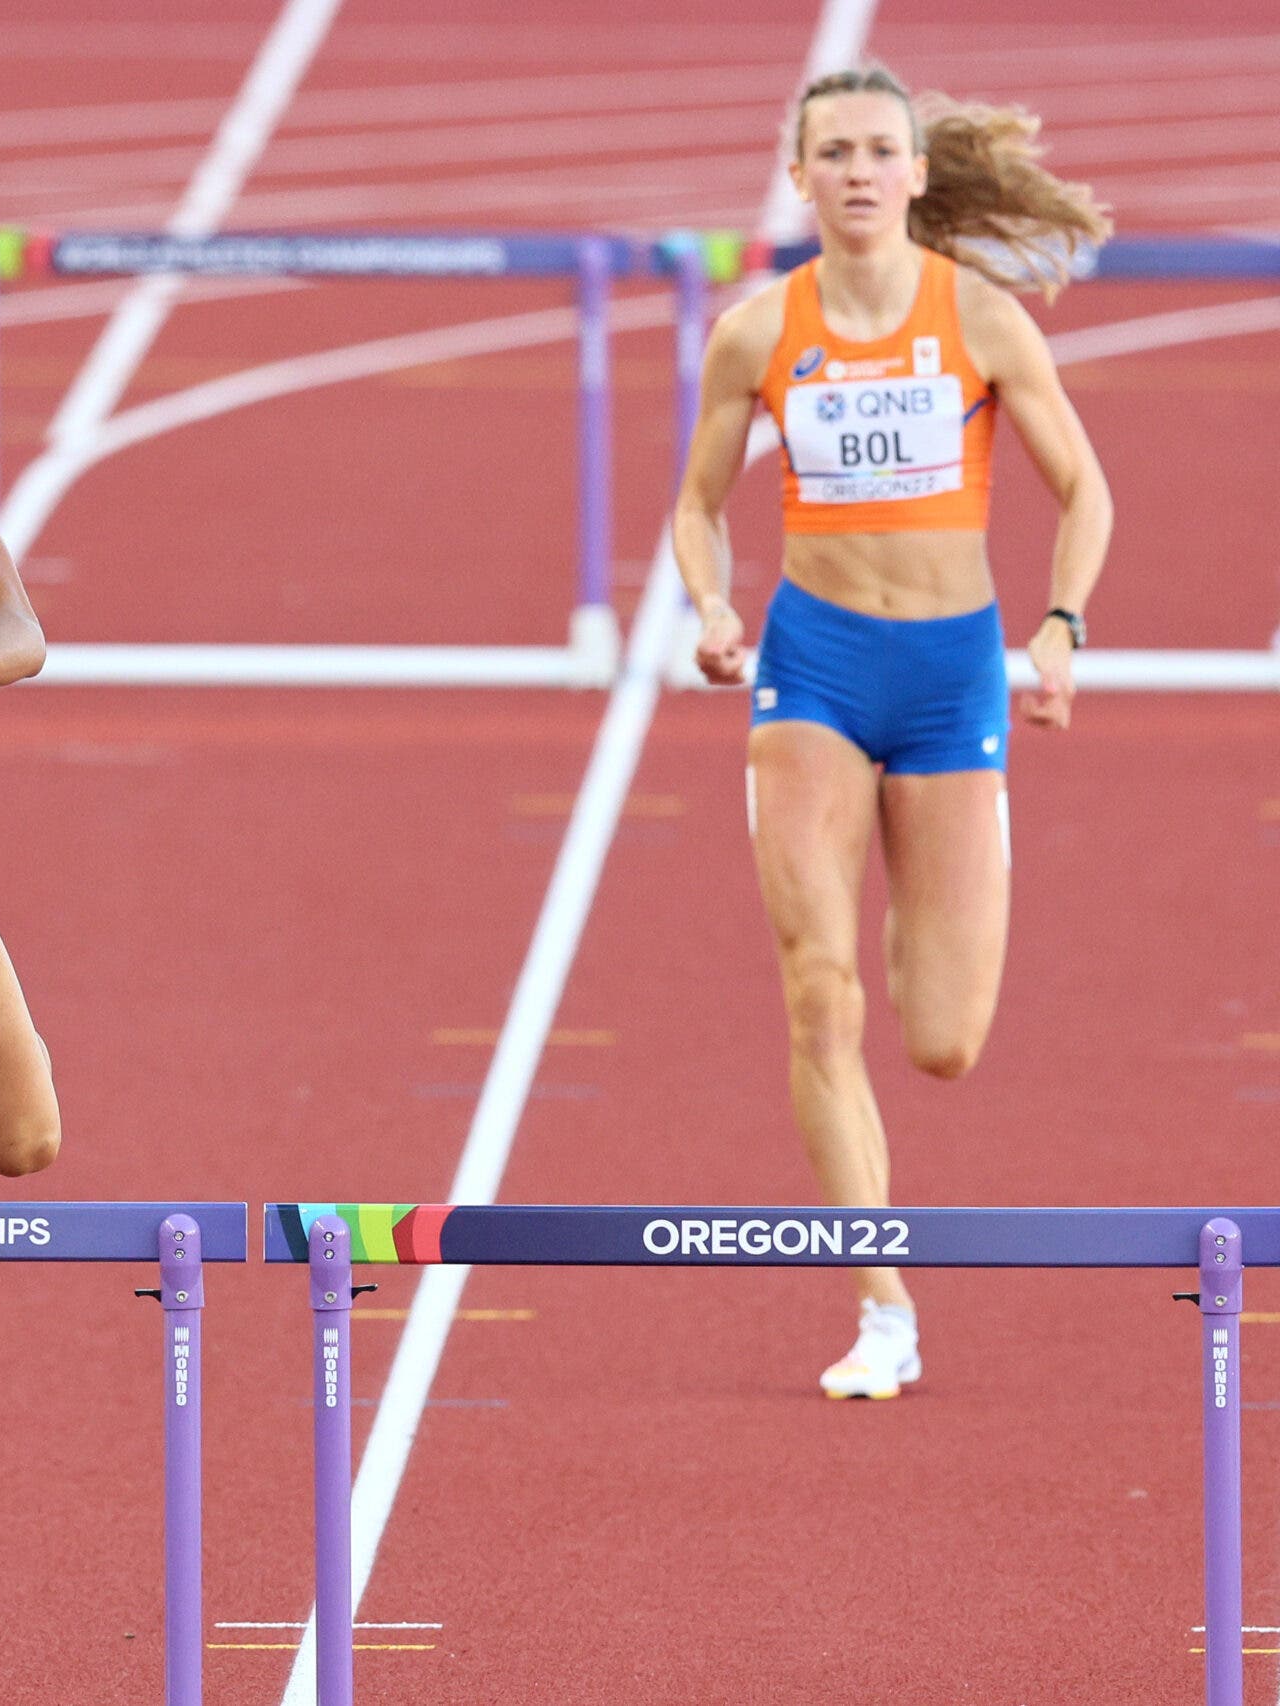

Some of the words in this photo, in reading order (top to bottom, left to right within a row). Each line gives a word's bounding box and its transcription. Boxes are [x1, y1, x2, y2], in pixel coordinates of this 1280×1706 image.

[856, 388, 933, 418] QNB
[839, 430, 913, 467] BOL
[174, 1344, 190, 1407] MONDO
[323, 1346, 339, 1408] MONDO
[1213, 1347, 1229, 1408] MONDO
